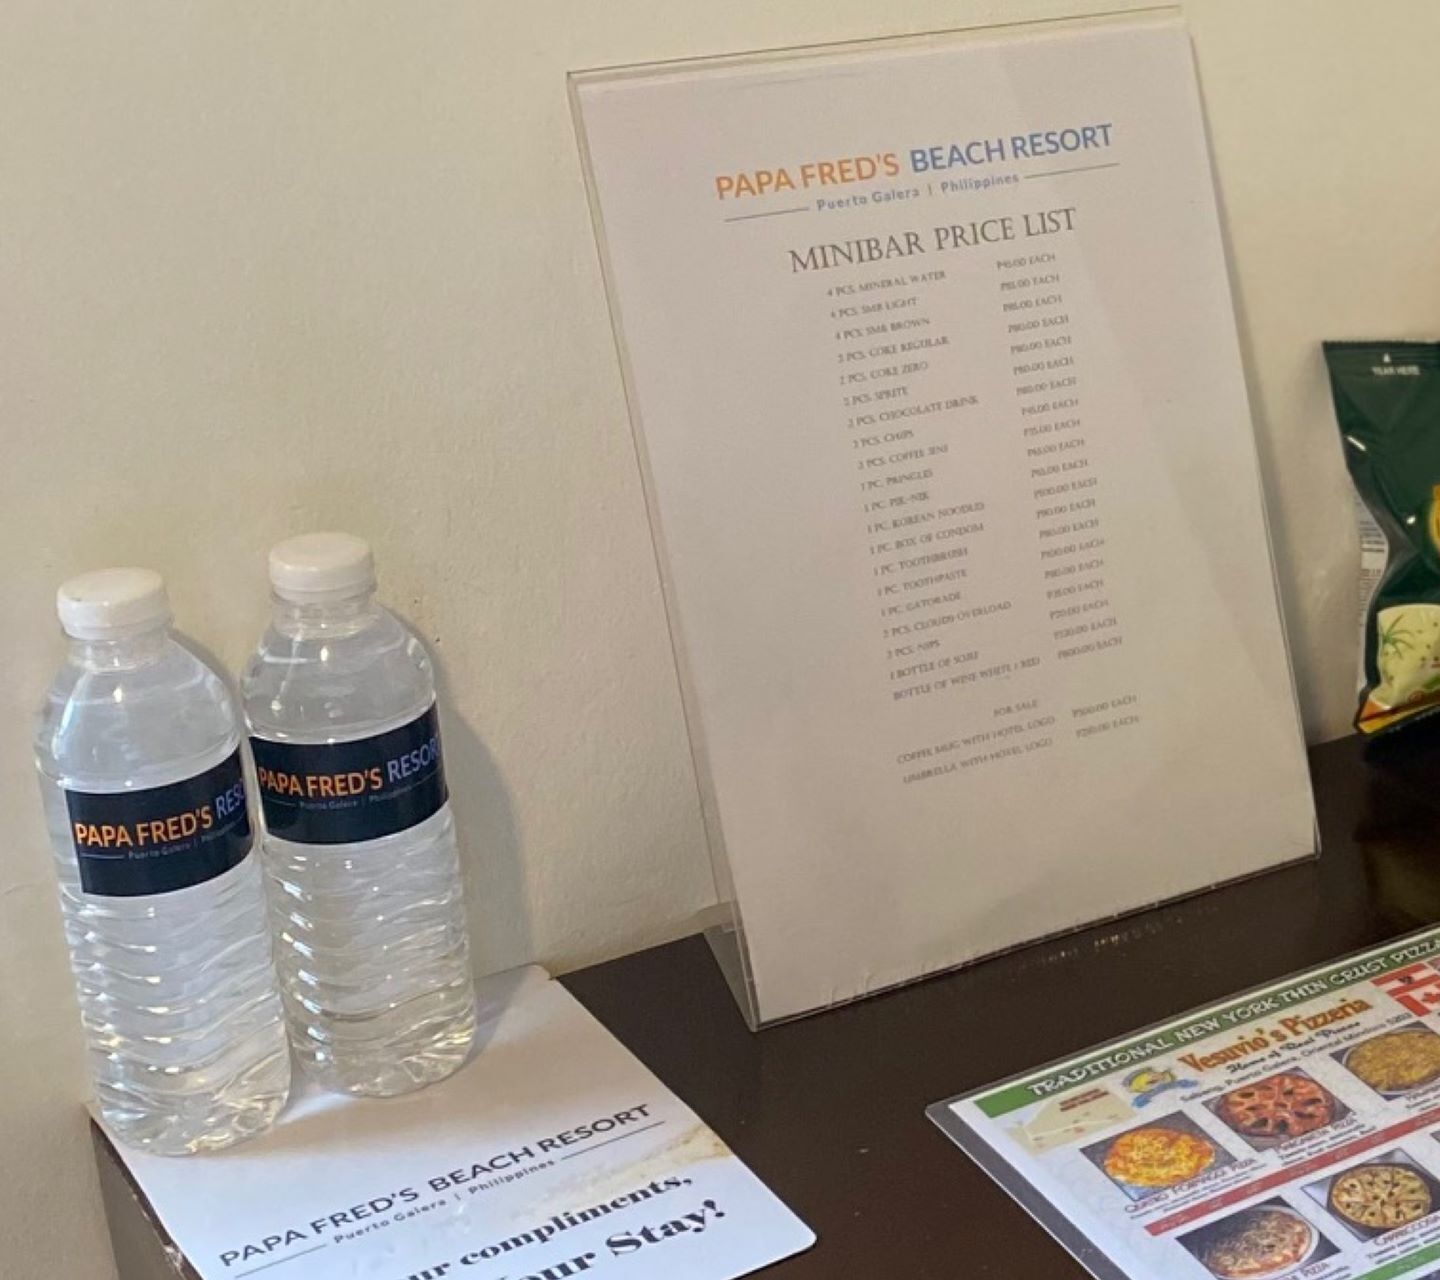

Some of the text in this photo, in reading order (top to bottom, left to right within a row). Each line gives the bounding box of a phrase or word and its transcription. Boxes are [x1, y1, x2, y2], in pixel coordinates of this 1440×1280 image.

[716, 122, 1113, 200] PAPA FRED'S BEACH RESORT
[816, 173, 1020, 212] Puerto Galera Philippines
[788, 206, 1076, 274] MINIBAR PRICE LIST
[1028, 251, 1056, 265] EACH
[257, 766, 304, 797] PAPA
[306, 766, 383, 798] FRED'S
[74, 822, 133, 848] PAPA
[136, 804, 214, 846] FRED'S
[1027, 1038, 1173, 1095] TRADITIONAL
[1174, 1017, 1219, 1041] NEW
[1221, 997, 1278, 1022] YORK
[1277, 980, 1327, 1002] THIN
[1329, 957, 1387, 984] CRUST
[1177, 998, 1372, 1071] Vesuvio's Pizzeria
[219, 1102, 652, 1268] PAPA FRED'S BEACH RESORT
[333, 1158, 556, 1245] Puerto Galera Philippines
[458, 1176, 695, 1268] compliments,
[605, 1199, 726, 1258] Stay!
